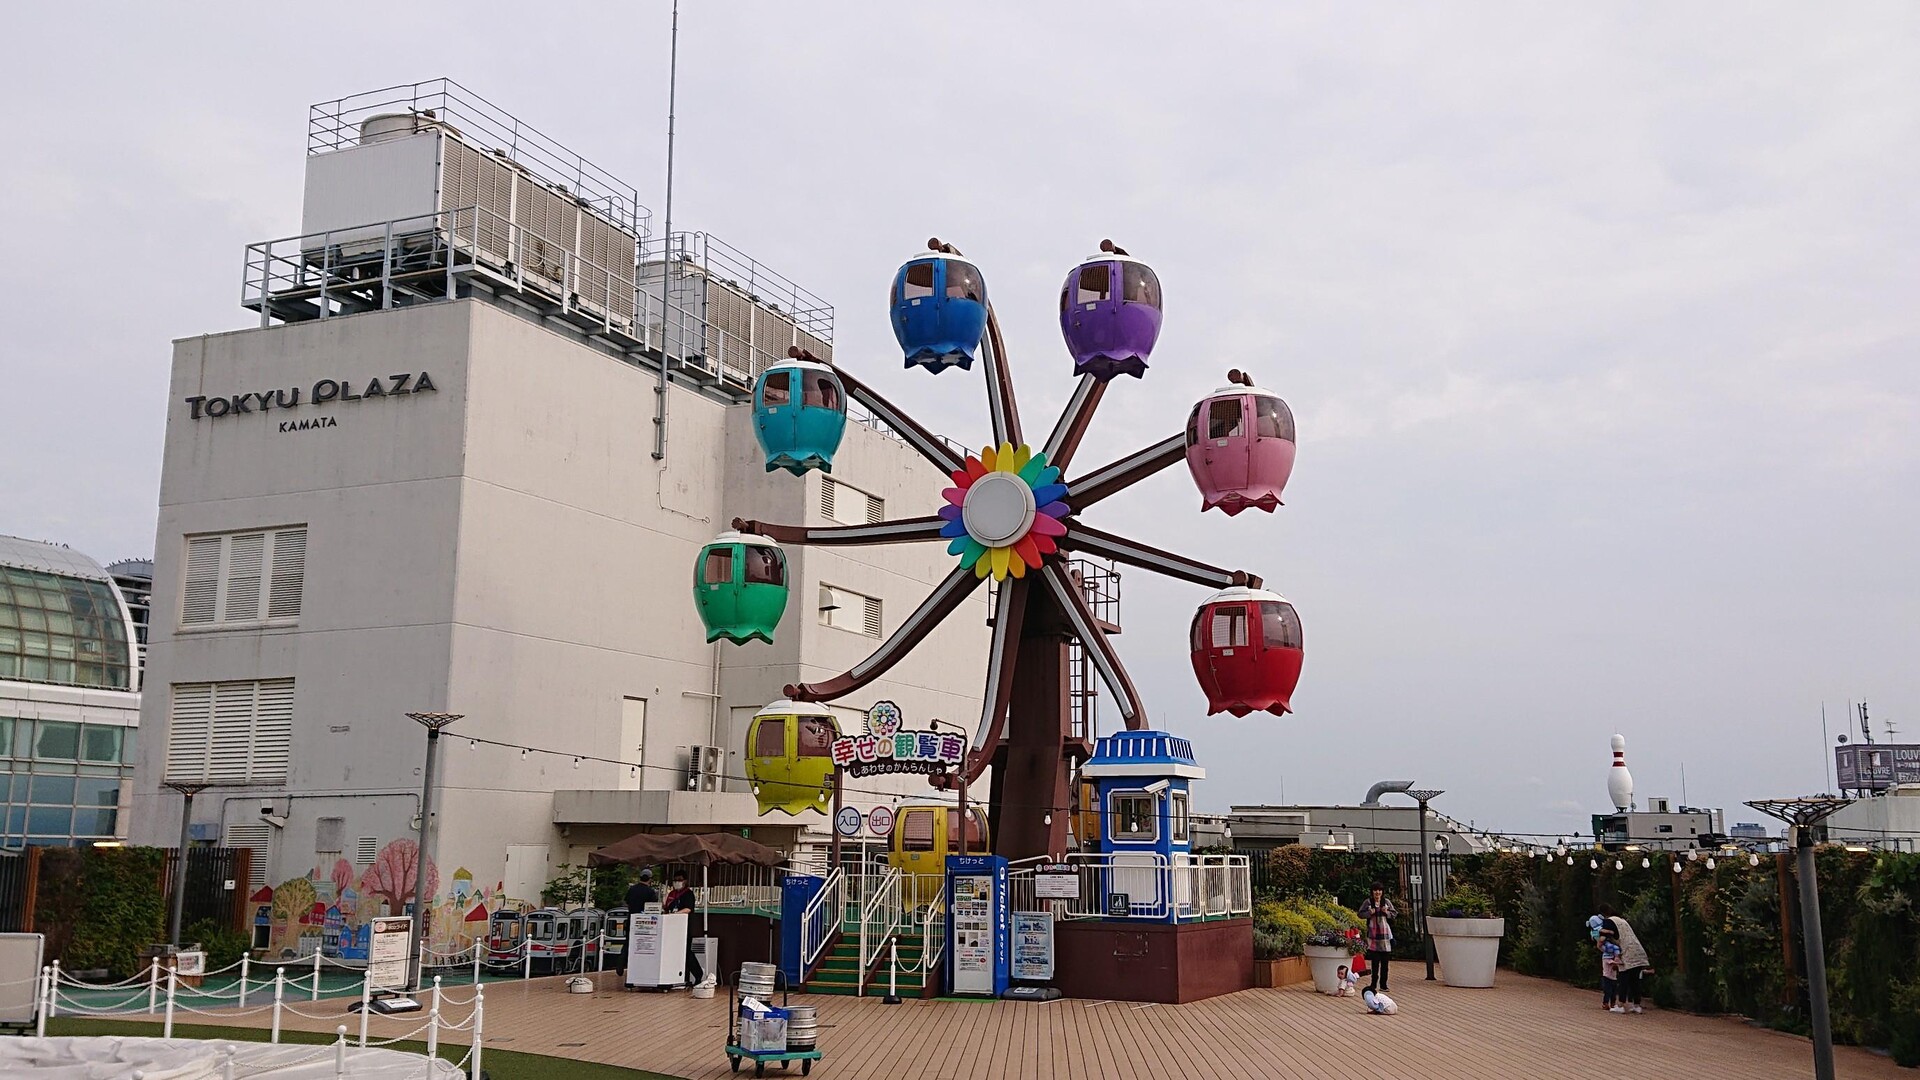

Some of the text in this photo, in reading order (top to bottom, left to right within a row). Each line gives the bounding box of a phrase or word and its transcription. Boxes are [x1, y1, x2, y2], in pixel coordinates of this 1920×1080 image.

[185, 371, 437, 419] TOKYU PLAZA
[279, 416, 337, 433] KAMATA
[834, 734, 962, 763] 幸せの観覧車
[1896, 749, 1920, 760] LOUV
[852, 762, 943, 776] しあわせのかんらんしゃ
[839, 815, 858, 827] 入口
[871, 815, 890, 827] 出口
[958, 857, 984, 865] ちけっと
